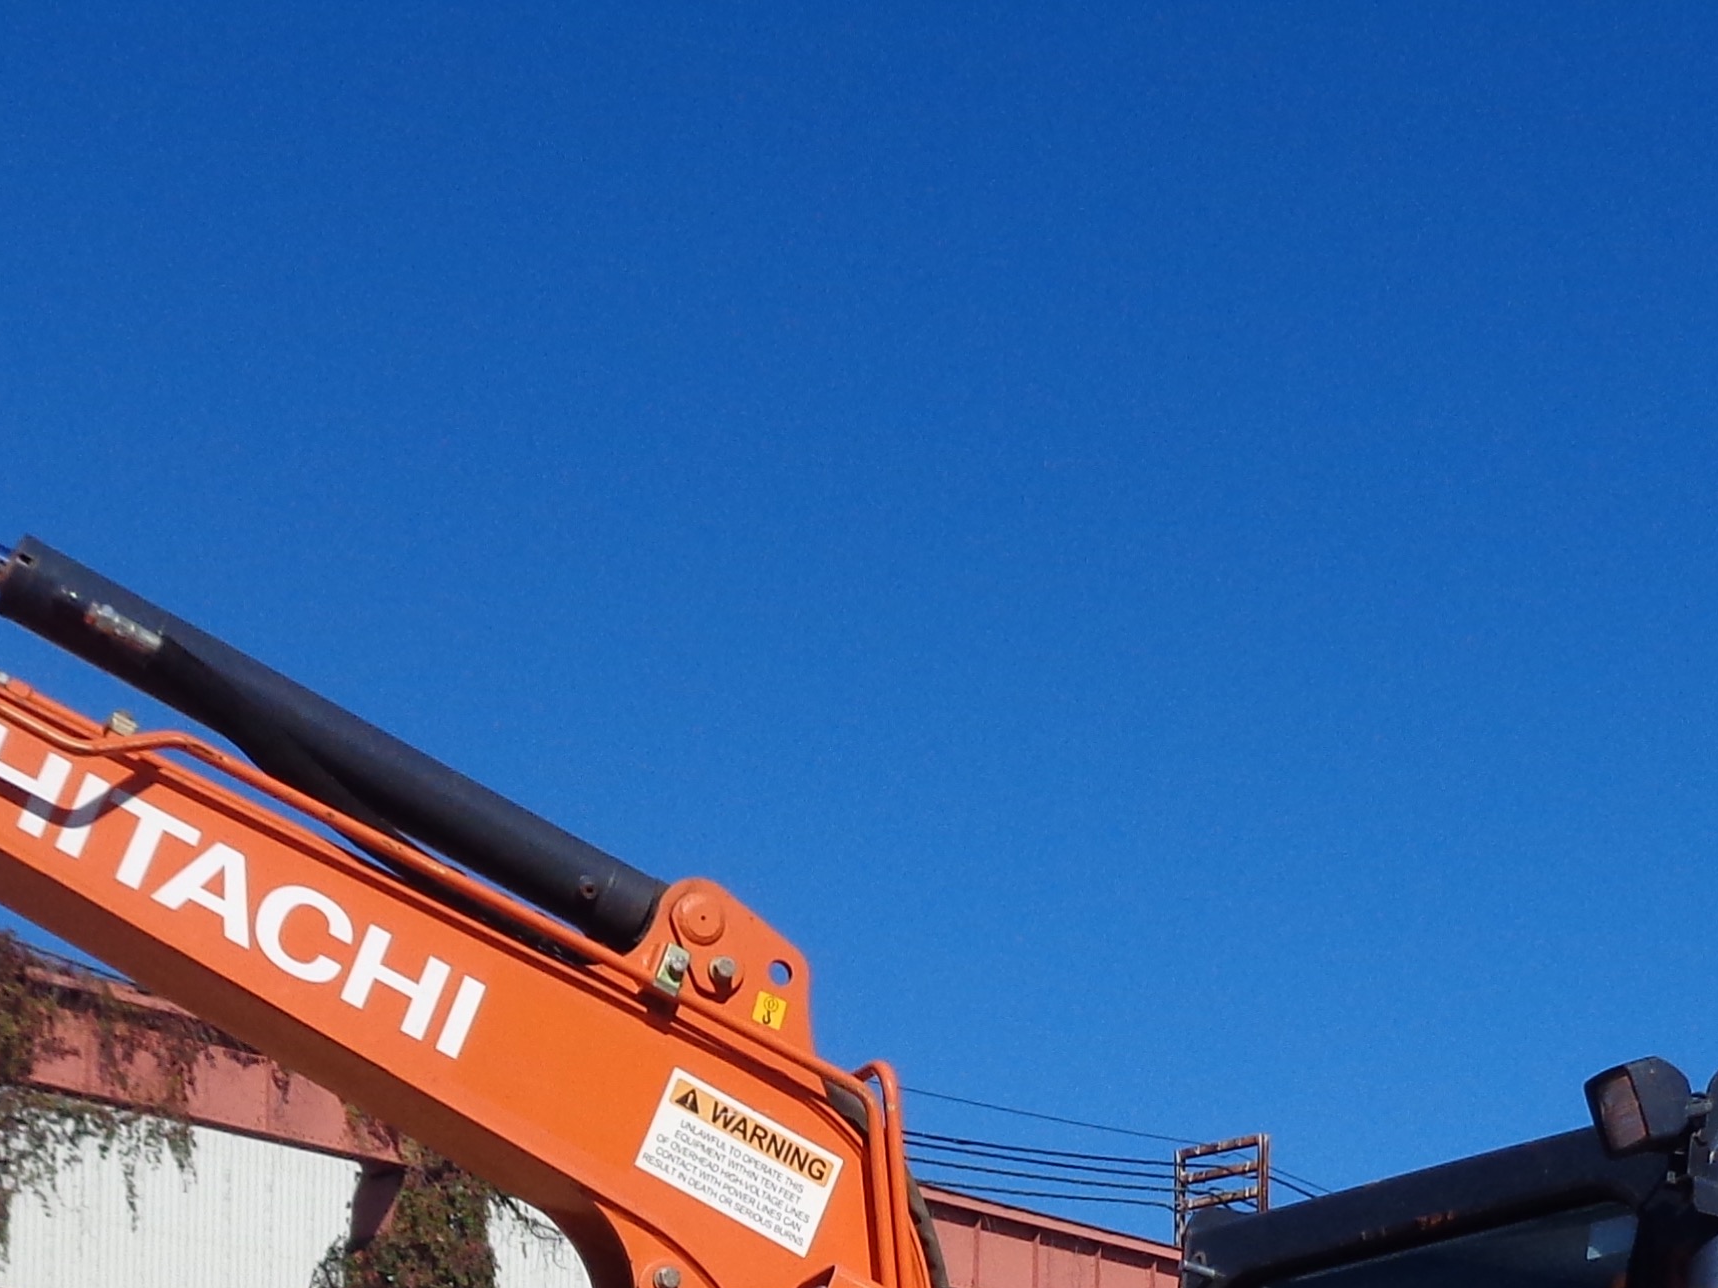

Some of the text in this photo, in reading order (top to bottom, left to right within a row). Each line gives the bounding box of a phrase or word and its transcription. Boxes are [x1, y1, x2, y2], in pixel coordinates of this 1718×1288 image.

[656, 1133, 669, 1145] OF
[669, 1140, 719, 1173] OVERHEAD
[674, 1129, 800, 1205] EQUIPMENT WITHIN TEN FEET
[679, 1119, 804, 1193] UNLAWFUL TO OPERATE THIS
[711, 1100, 828, 1182] WARNING
[642, 1152, 675, 1176] RESULT
[677, 1171, 687, 1182] IN
[687, 1177, 717, 1199] DEATH
[718, 1194, 732, 1207] OR
[733, 1202, 772, 1229] SERIOUS
[655, 1146, 801, 1232] CONTACT WITH POWER LINES CAN
